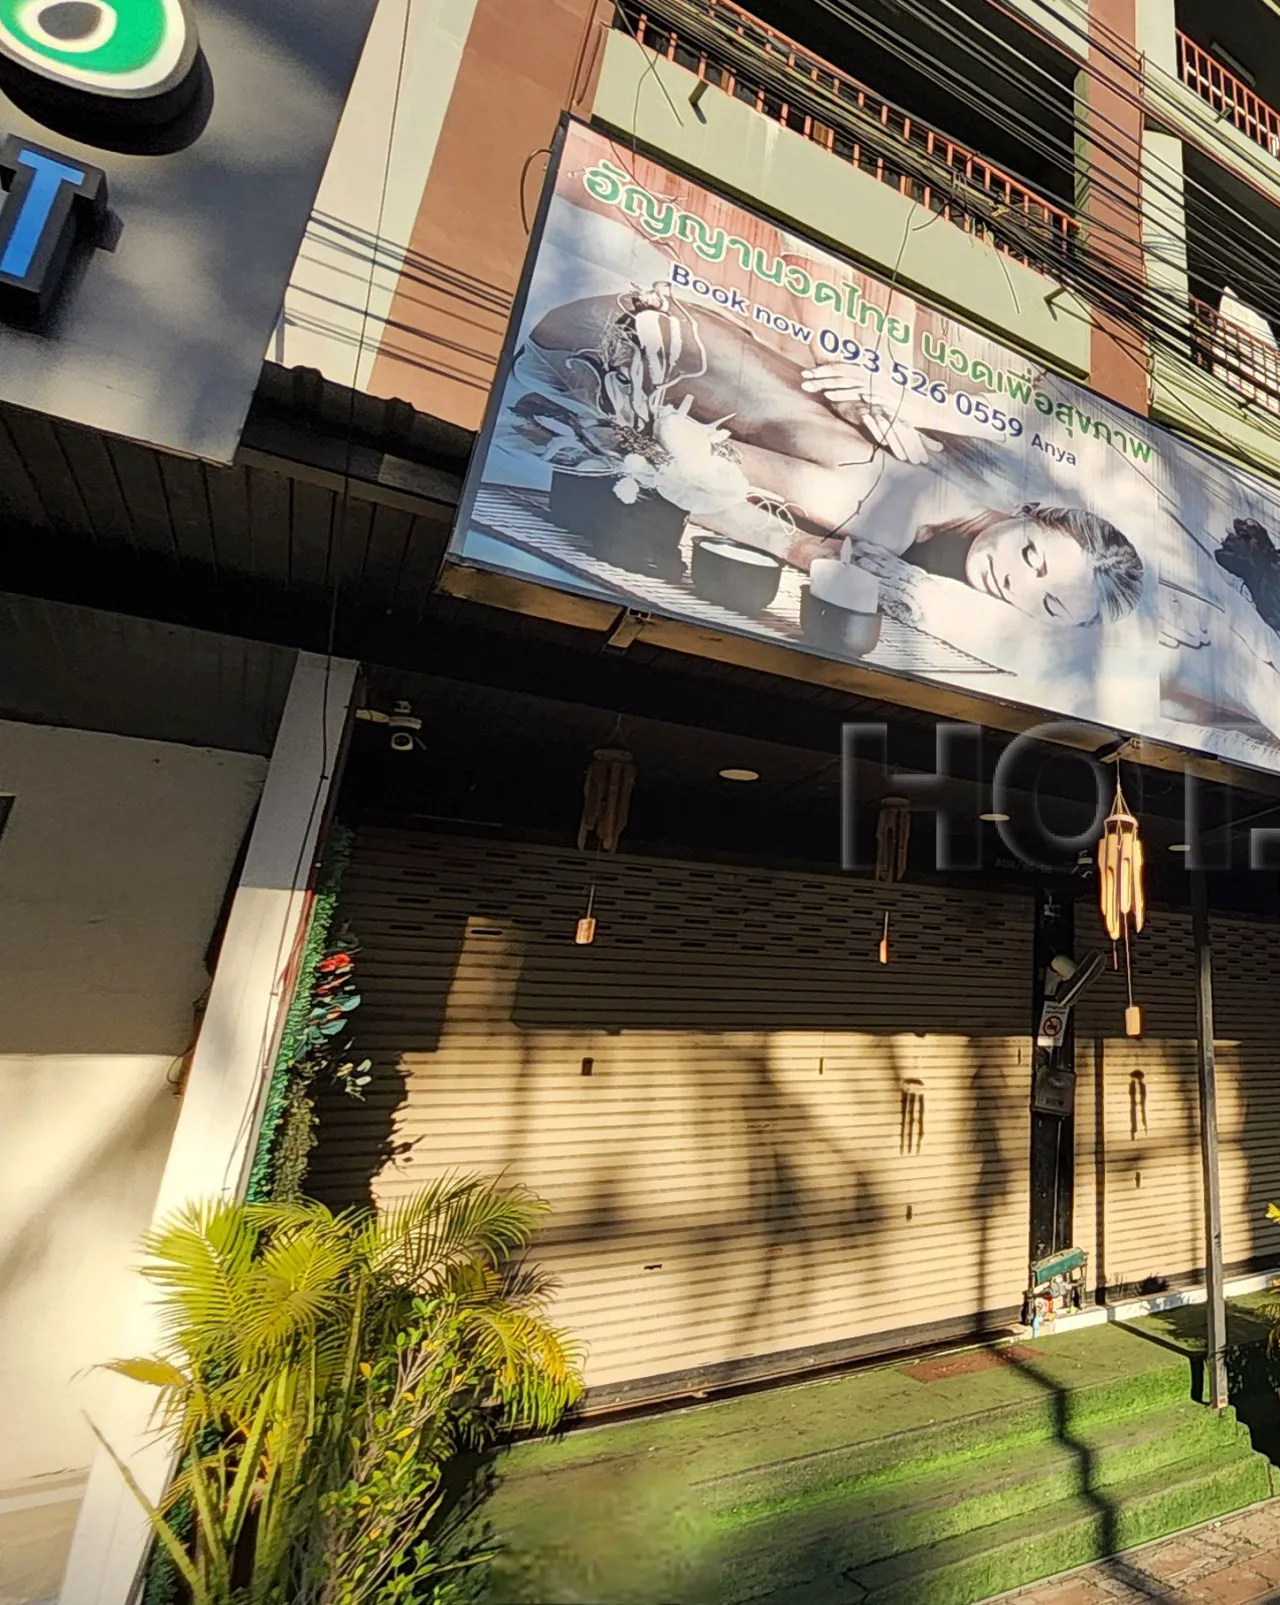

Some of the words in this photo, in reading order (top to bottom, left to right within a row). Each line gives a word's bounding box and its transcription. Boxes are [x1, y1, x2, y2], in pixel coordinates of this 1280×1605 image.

[583, 160, 912, 346] อัญญานวดไทย
[921, 332, 1153, 465] นวดเพื่อสุขภาพ
[671, 262, 748, 315] Book
[755, 303, 812, 345] now
[819, 328, 881, 374] 093
[890, 361, 947, 405] 526
[955, 392, 1025, 438] 0559
[1030, 432, 1078, 468] Anya
